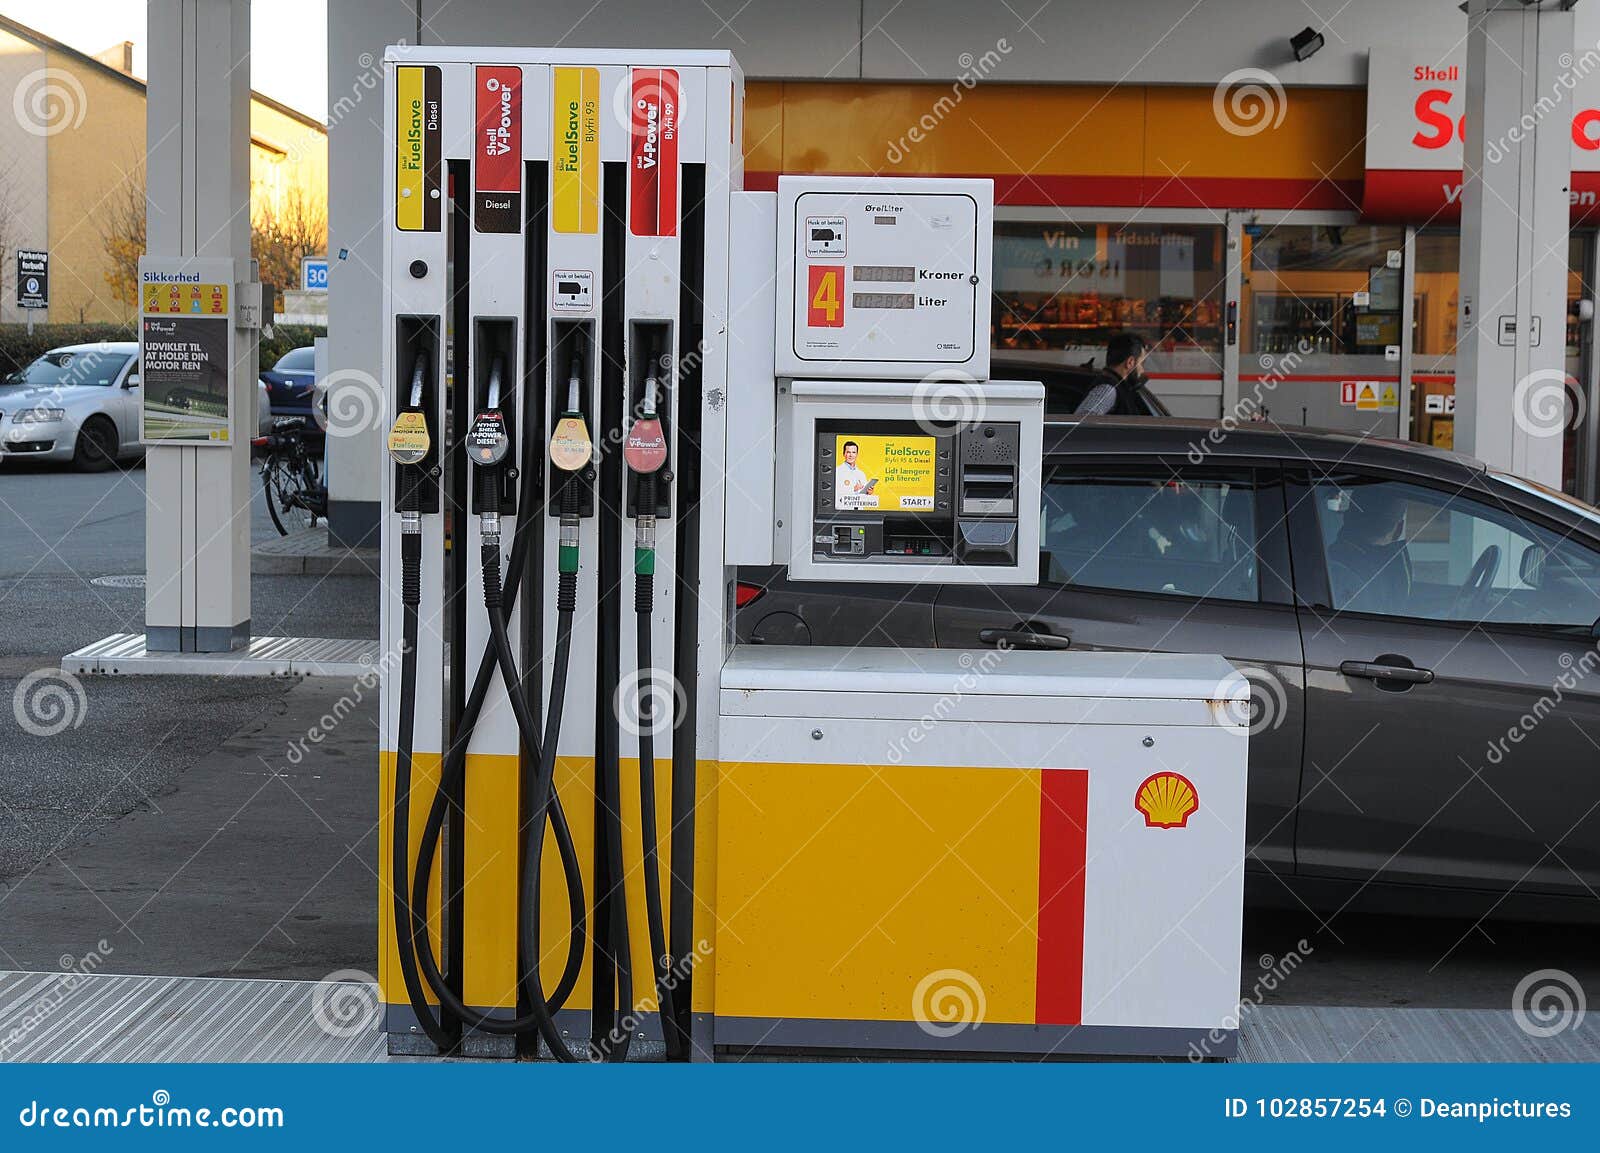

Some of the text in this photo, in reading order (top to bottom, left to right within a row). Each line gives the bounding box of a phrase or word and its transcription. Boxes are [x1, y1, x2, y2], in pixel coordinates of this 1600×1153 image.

[1414, 66, 1458, 81] Shell
[428, 101, 438, 131] Diesel
[497, 84, 512, 156] V-Power
[585, 101, 597, 142] Blyfri 95
[664, 103, 675, 140] Blyfri 99
[1412, 89, 1466, 150] S
[408, 100, 421, 170] FuelSave
[486, 129, 497, 156] Shell
[565, 101, 578, 172] FuelSave
[643, 103, 657, 170] V-Power
[485, 199, 511, 209] Diesel
[1042, 230, 1080, 249] Vin
[143, 272, 200, 282] Sikkerhed
[919, 269, 965, 280] Kroner
[812, 271, 840, 321] 4
[918, 296, 948, 307] Liter
[145, 342, 202, 352] UDVIKLET TIL
[145, 352, 209, 361] AT HOLDE DIN
[145, 361, 201, 370] MOTOR REN
[885, 446, 931, 456] FuelSave
[900, 467, 930, 476] længere
[902, 498, 927, 506] START
